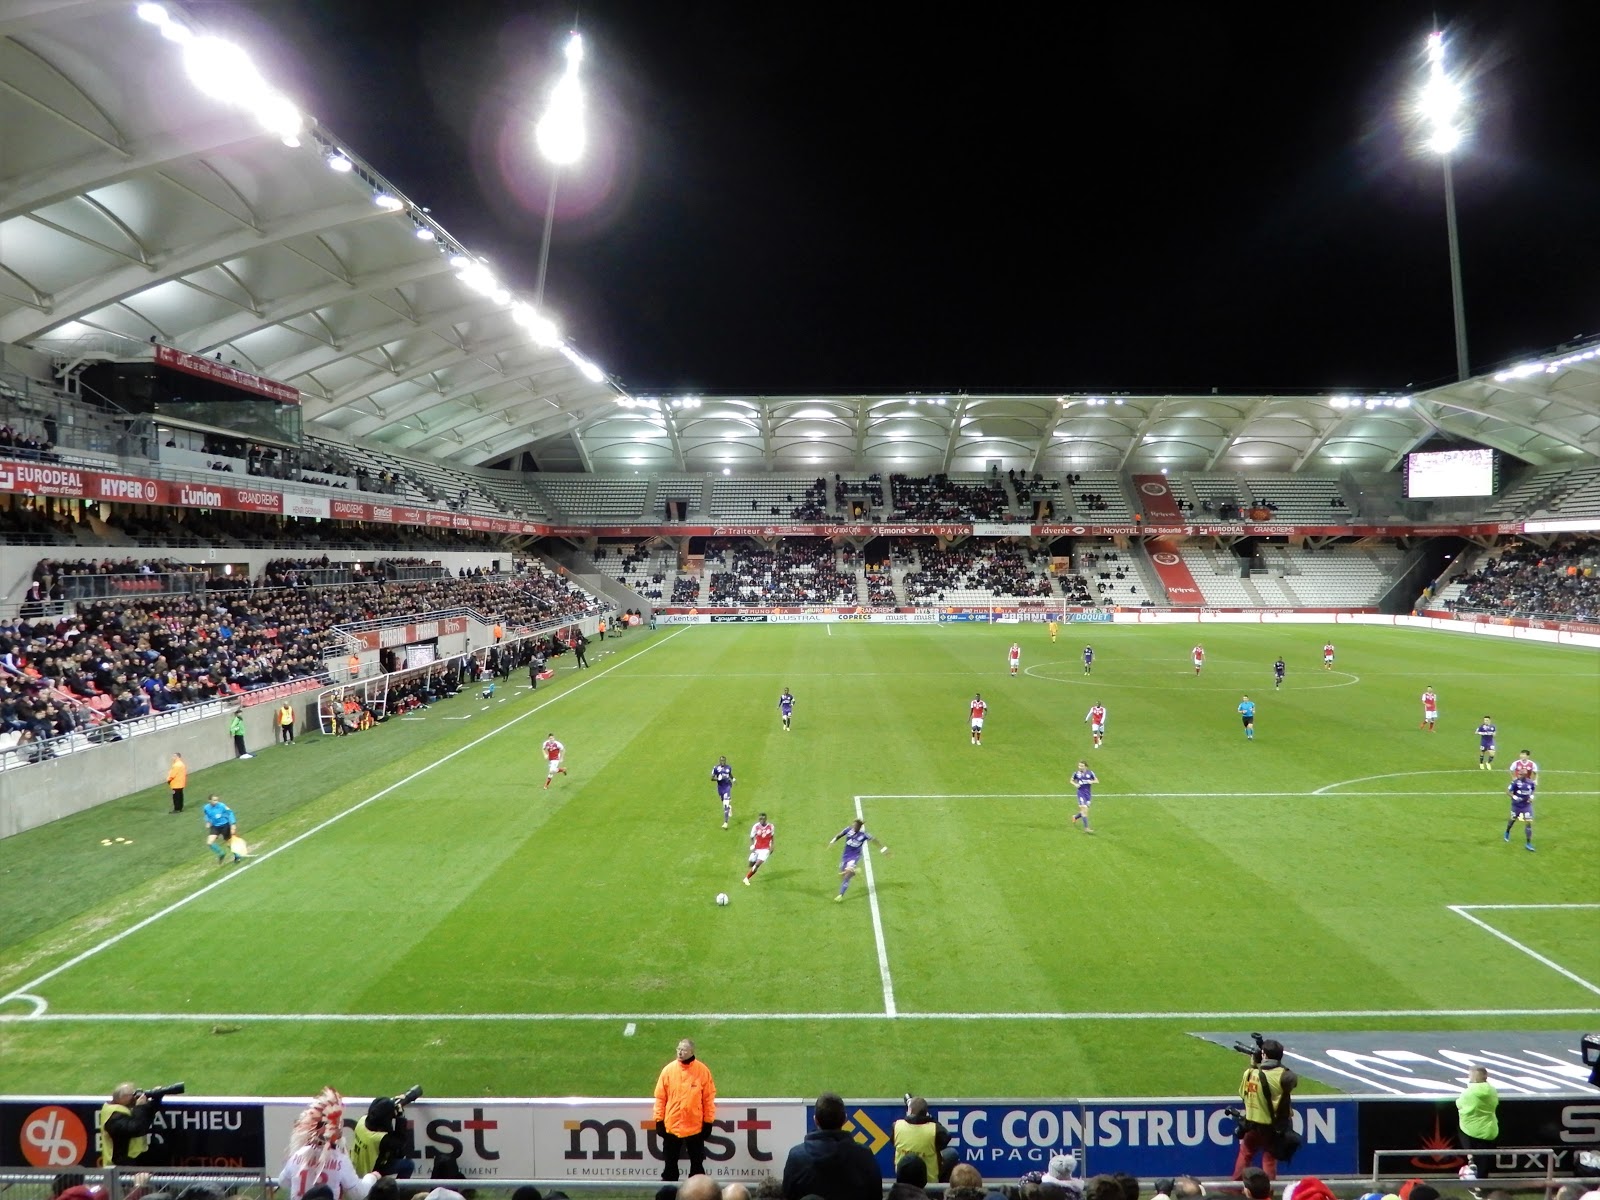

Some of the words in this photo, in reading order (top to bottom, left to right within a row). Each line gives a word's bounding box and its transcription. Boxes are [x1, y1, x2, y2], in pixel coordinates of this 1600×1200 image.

[16, 466, 83, 487] EURODEAL
[38, 484, 59, 494] Agence
[101, 478, 143, 498] HYPER
[1041, 526, 1070, 534] idverde
[1158, 526, 1182, 534] Sécurité
[563, 1107, 773, 1163] mst
[1001, 1107, 1336, 1148] CONSTRUCN
[566, 1167, 578, 1176] LE
[582, 1167, 658, 1176] MULTISERVICE
[717, 1165, 772, 1177] BÂTIMENT
